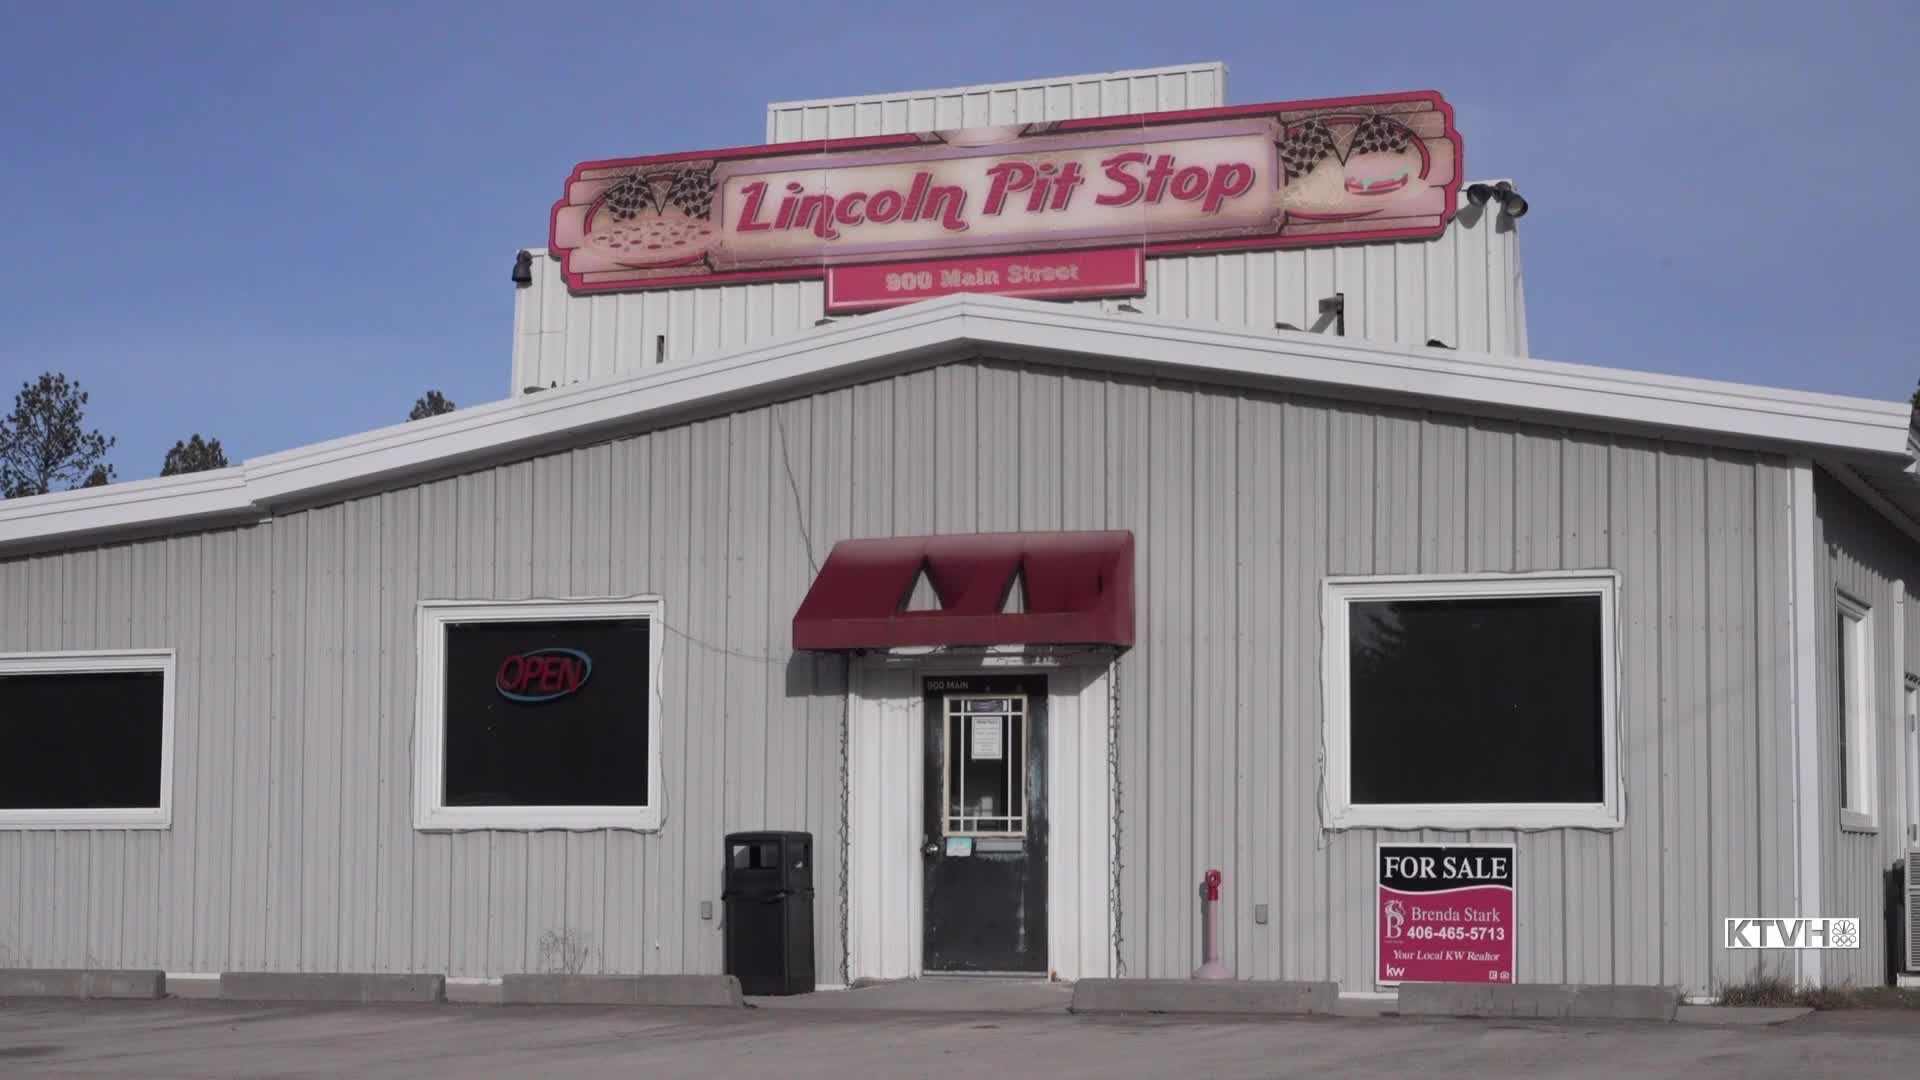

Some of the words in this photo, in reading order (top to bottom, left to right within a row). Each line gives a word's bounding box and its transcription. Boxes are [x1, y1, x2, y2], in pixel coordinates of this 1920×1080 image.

[736, 171, 969, 240] Lincoln
[982, 161, 1084, 216] Pit
[1096, 152, 1255, 214] Stop
[886, 271, 933, 292] 900
[940, 268, 1000, 288] Main
[1007, 263, 1079, 284] Street
[499, 655, 584, 693] OPEN
[946, 680, 969, 689] MAIN
[1384, 856, 1437, 879] FOR
[1442, 856, 1508, 879] SALE
[1411, 907, 1460, 921] Brenda
[1464, 907, 1501, 922] Stark
[1407, 926, 1505, 940] 406-465-5713
[1393, 950, 1415, 960] Your
[1416, 950, 1443, 960] Local
[1445, 951, 1465, 960] KW
[1467, 951, 1501, 961] Realtor
[1386, 963, 1405, 977] kw
